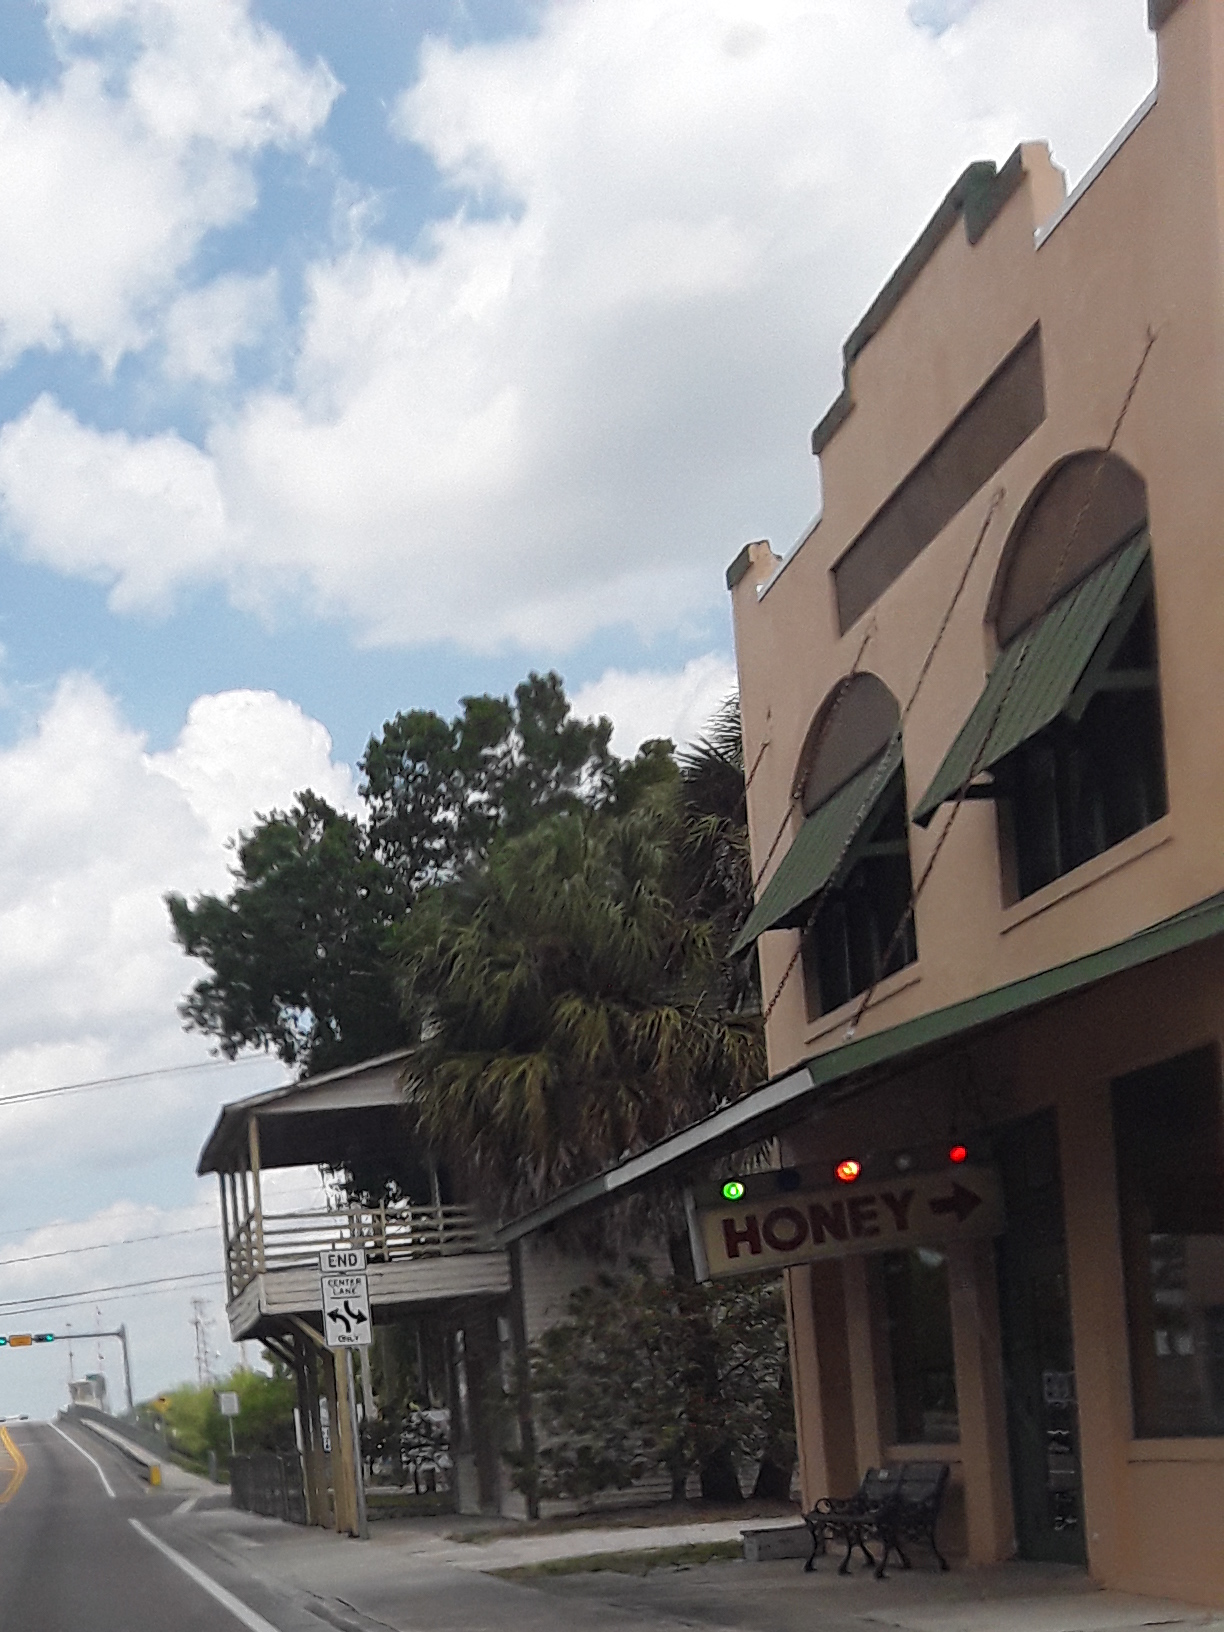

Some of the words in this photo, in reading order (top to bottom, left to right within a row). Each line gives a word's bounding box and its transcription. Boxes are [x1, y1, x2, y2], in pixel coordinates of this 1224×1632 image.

[722, 1189, 914, 1258] HONEY
[328, 1253, 358, 1268] END
[327, 1278, 362, 1287] CENTER
[332, 1287, 357, 1295] LANE
